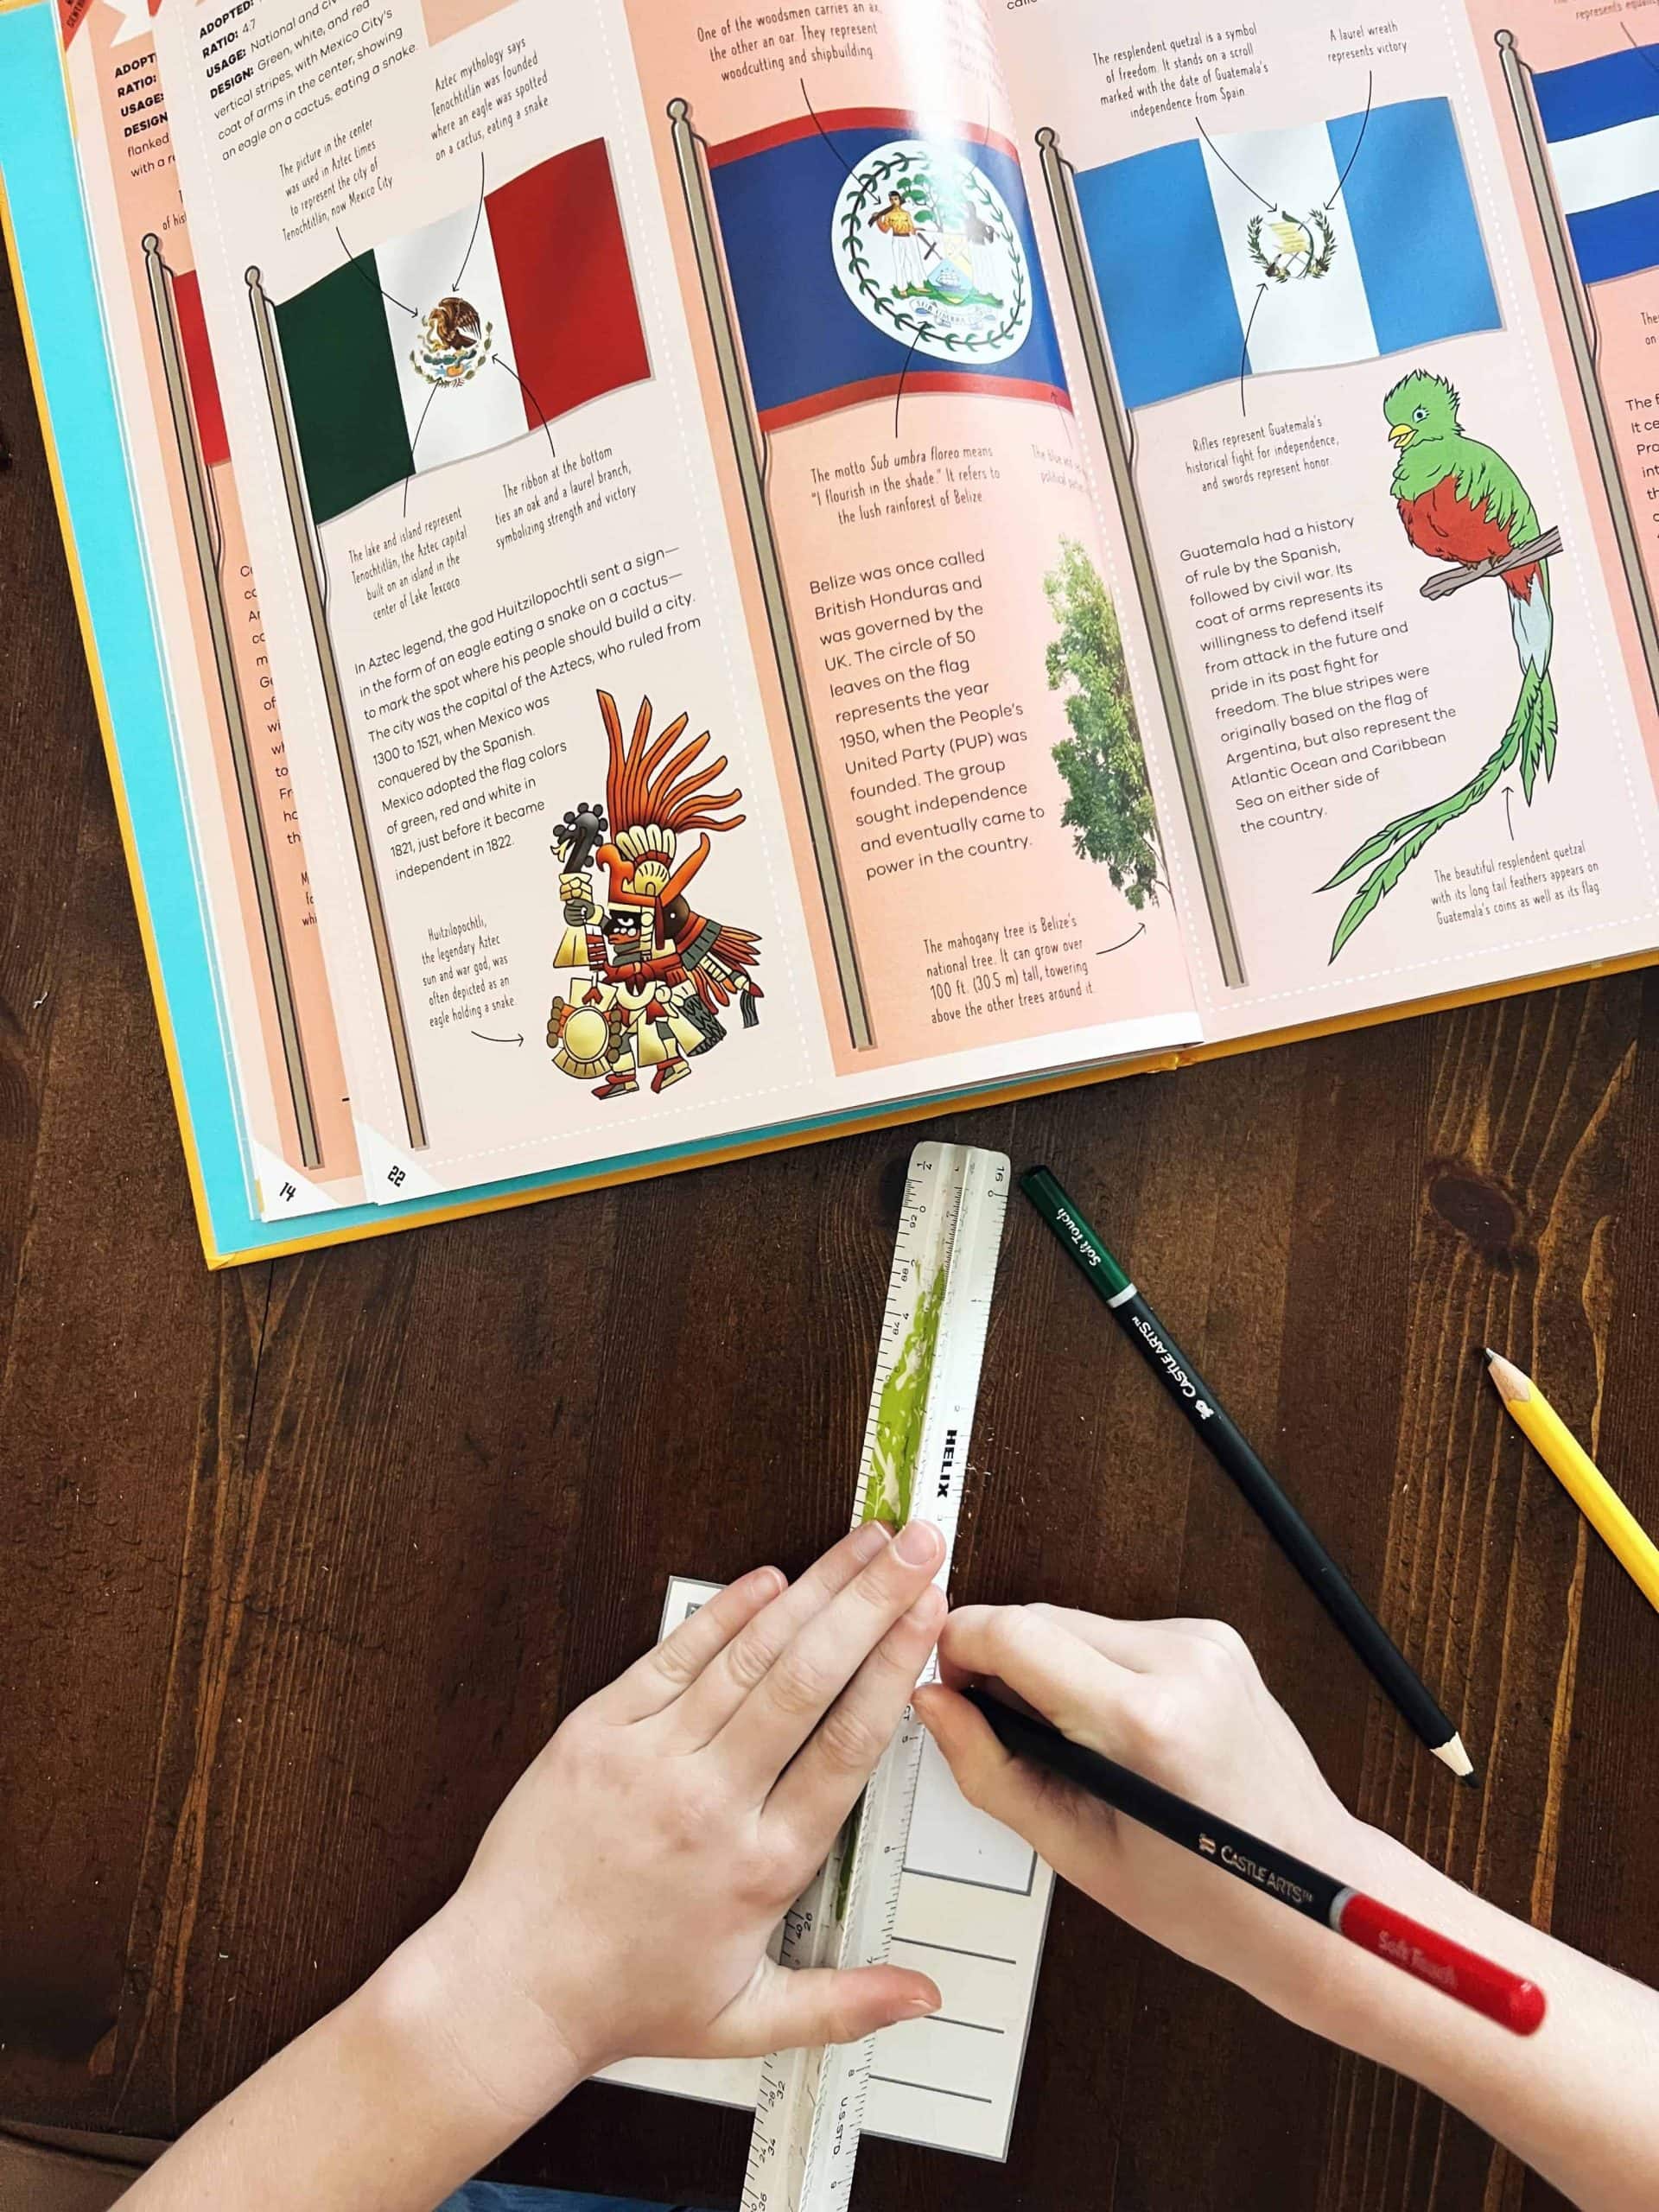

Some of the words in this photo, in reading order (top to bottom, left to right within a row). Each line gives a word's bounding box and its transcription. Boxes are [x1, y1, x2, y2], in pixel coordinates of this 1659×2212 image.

[200, 0, 254, 39] ADOPTED:
[1330, 29, 1337, 42] A
[1338, 24, 1364, 41] laurel
[1367, 21, 1398, 35] wreath
[202, 30, 238, 59] RATIO:
[210, 67, 254, 99] DESIGN:
[327, 9, 349, 29] and
[352, 0, 370, 16] red
[213, 89, 253, 119] vertical
[295, 53, 318, 73] with
[320, 29, 359, 58] Mexico
[361, 10, 392, 33] City's
[435, 73, 457, 92] Aztec
[460, 49, 504, 79] mythology
[507, 38, 526, 54] says
[721, 58, 785, 82] woodcutting
[788, 49, 807, 66] and
[810, 42, 874, 63] shipbuilding
[1092, 52, 1109, 66] The
[1113, 40, 1167, 62] resplendent
[1170, 33, 1203, 53] quetzal
[1205, 34, 1214, 42] is
[1217, 32, 1223, 41] a
[1225, 23, 1257, 42] symbol
[1327, 44, 1374, 64] represents
[1376, 41, 1407, 54] victory
[118, 74, 156, 98] RATIO:
[483, 74, 500, 89] was
[502, 50, 538, 79] founded
[120, 92, 164, 118] USAGE:
[285, 182, 300, 197] was
[302, 168, 320, 188] used
[321, 166, 329, 177] in
[331, 153, 353, 172] Aztec
[353, 140, 376, 159] times
[1185, 453, 1229, 474] historical
[1231, 448, 1255, 467] fight
[1256, 445, 1270, 460] for
[496, 520, 545, 550] symbolizing
[547, 500, 583, 527] strength
[586, 492, 602, 512] and
[605, 485, 636, 504] victory
[837, 508, 855, 525] the
[859, 502, 881, 520] lush
[886, 493, 937, 515] rainforest
[940, 491, 950, 506] of
[953, 488, 982, 505] Belize
[1179, 535, 1260, 562] Guatemala
[1262, 526, 1291, 543] had
[1294, 527, 1304, 537] a
[1306, 518, 1354, 534] history
[810, 575, 856, 594] Belize
[859, 567, 892, 582] was
[895, 559, 935, 575] once
[938, 549, 985, 568] called
[815, 596, 866, 620] British
[869, 583, 949, 607] Honduras
[952, 575, 982, 592] and
[1195, 613, 1229, 629] coat
[1231, 606, 1245, 621] of
[1249, 601, 1286, 617] arms
[1289, 585, 1363, 608] represents
[1366, 582, 1383, 593] its
[819, 630, 851, 645] was
[855, 608, 931, 640] governed
[934, 607, 953, 622] by
[957, 603, 983, 618] the
[367, 728, 391, 742] The
[393, 719, 414, 734] city
[416, 710, 441, 726] was
[442, 702, 462, 716] the
[465, 682, 508, 709] capital
[510, 675, 522, 692] of
[525, 671, 546, 686] the
[550, 655, 595, 678] Aztecs,
[597, 643, 626, 660] who
[628, 626, 664, 650] ruled
[667, 618, 701, 636] from
[830, 677, 881, 698] leaves
[885, 671, 905, 684] on
[908, 664, 935, 679] the
[939, 659, 969, 674] flag
[372, 747, 400, 766] 1300
[402, 744, 415, 756] to
[416, 733, 442, 750] 1521,
[443, 722, 476, 741] when
[478, 706, 523, 729] Mexico
[524, 696, 550, 712] was
[1220, 718, 1287, 742] originally
[1289, 706, 1334, 727] based
[1338, 705, 1356, 716] on
[1358, 699, 1382, 712] the
[1384, 694, 1412, 707] flag
[1415, 686, 1428, 701] of
[845, 750, 898, 775] United
[901, 744, 945, 762] Party
[950, 732, 994, 753] (PUP)
[997, 731, 1027, 744] was
[1231, 766, 1287, 788] Atlantic
[1290, 756, 1338, 774] Ocean
[1341, 747, 1369, 764] and
[1371, 734, 1446, 757] Caribbean
[381, 791, 423, 812] Mexico
[426, 769, 477, 797] adopted
[479, 765, 499, 779] the
[501, 756, 526, 772] flag
[528, 742, 567, 762] colors
[855, 803, 912, 827] sought
[914, 784, 1027, 813] independence
[866, 858, 914, 881] power
[918, 853, 933, 867] in
[937, 848, 963, 862] the
[968, 836, 1033, 856] country.
[1433, 869, 1452, 883] The
[1453, 858, 1495, 880] beautiful
[1497, 849, 1551, 871] resplendent
[1554, 840, 1586, 861] quetzal
[422, 951, 435, 965] the
[436, 941, 475, 963] legendary
[479, 935, 500, 950] Aztec
[923, 938, 943, 955] The
[947, 931, 1000, 950] mahogany
[1003, 925, 1025, 938] tree
[1028, 924, 1038, 934] is
[1039, 915, 1077, 932] Belize's
[279, 1182, 296, 1202] 14
[387, 1166, 406, 1187] 22
[909, 1214, 918, 1229] 92
[1056, 1208, 1084, 1244] Touch
[1080, 1241, 1101, 1266] Soft
[900, 1268, 909, 1282] 88
[937, 1429, 957, 1497] HELIX
[775, 2081, 785, 2100] 32
[767, 2139, 776, 2157] 34
